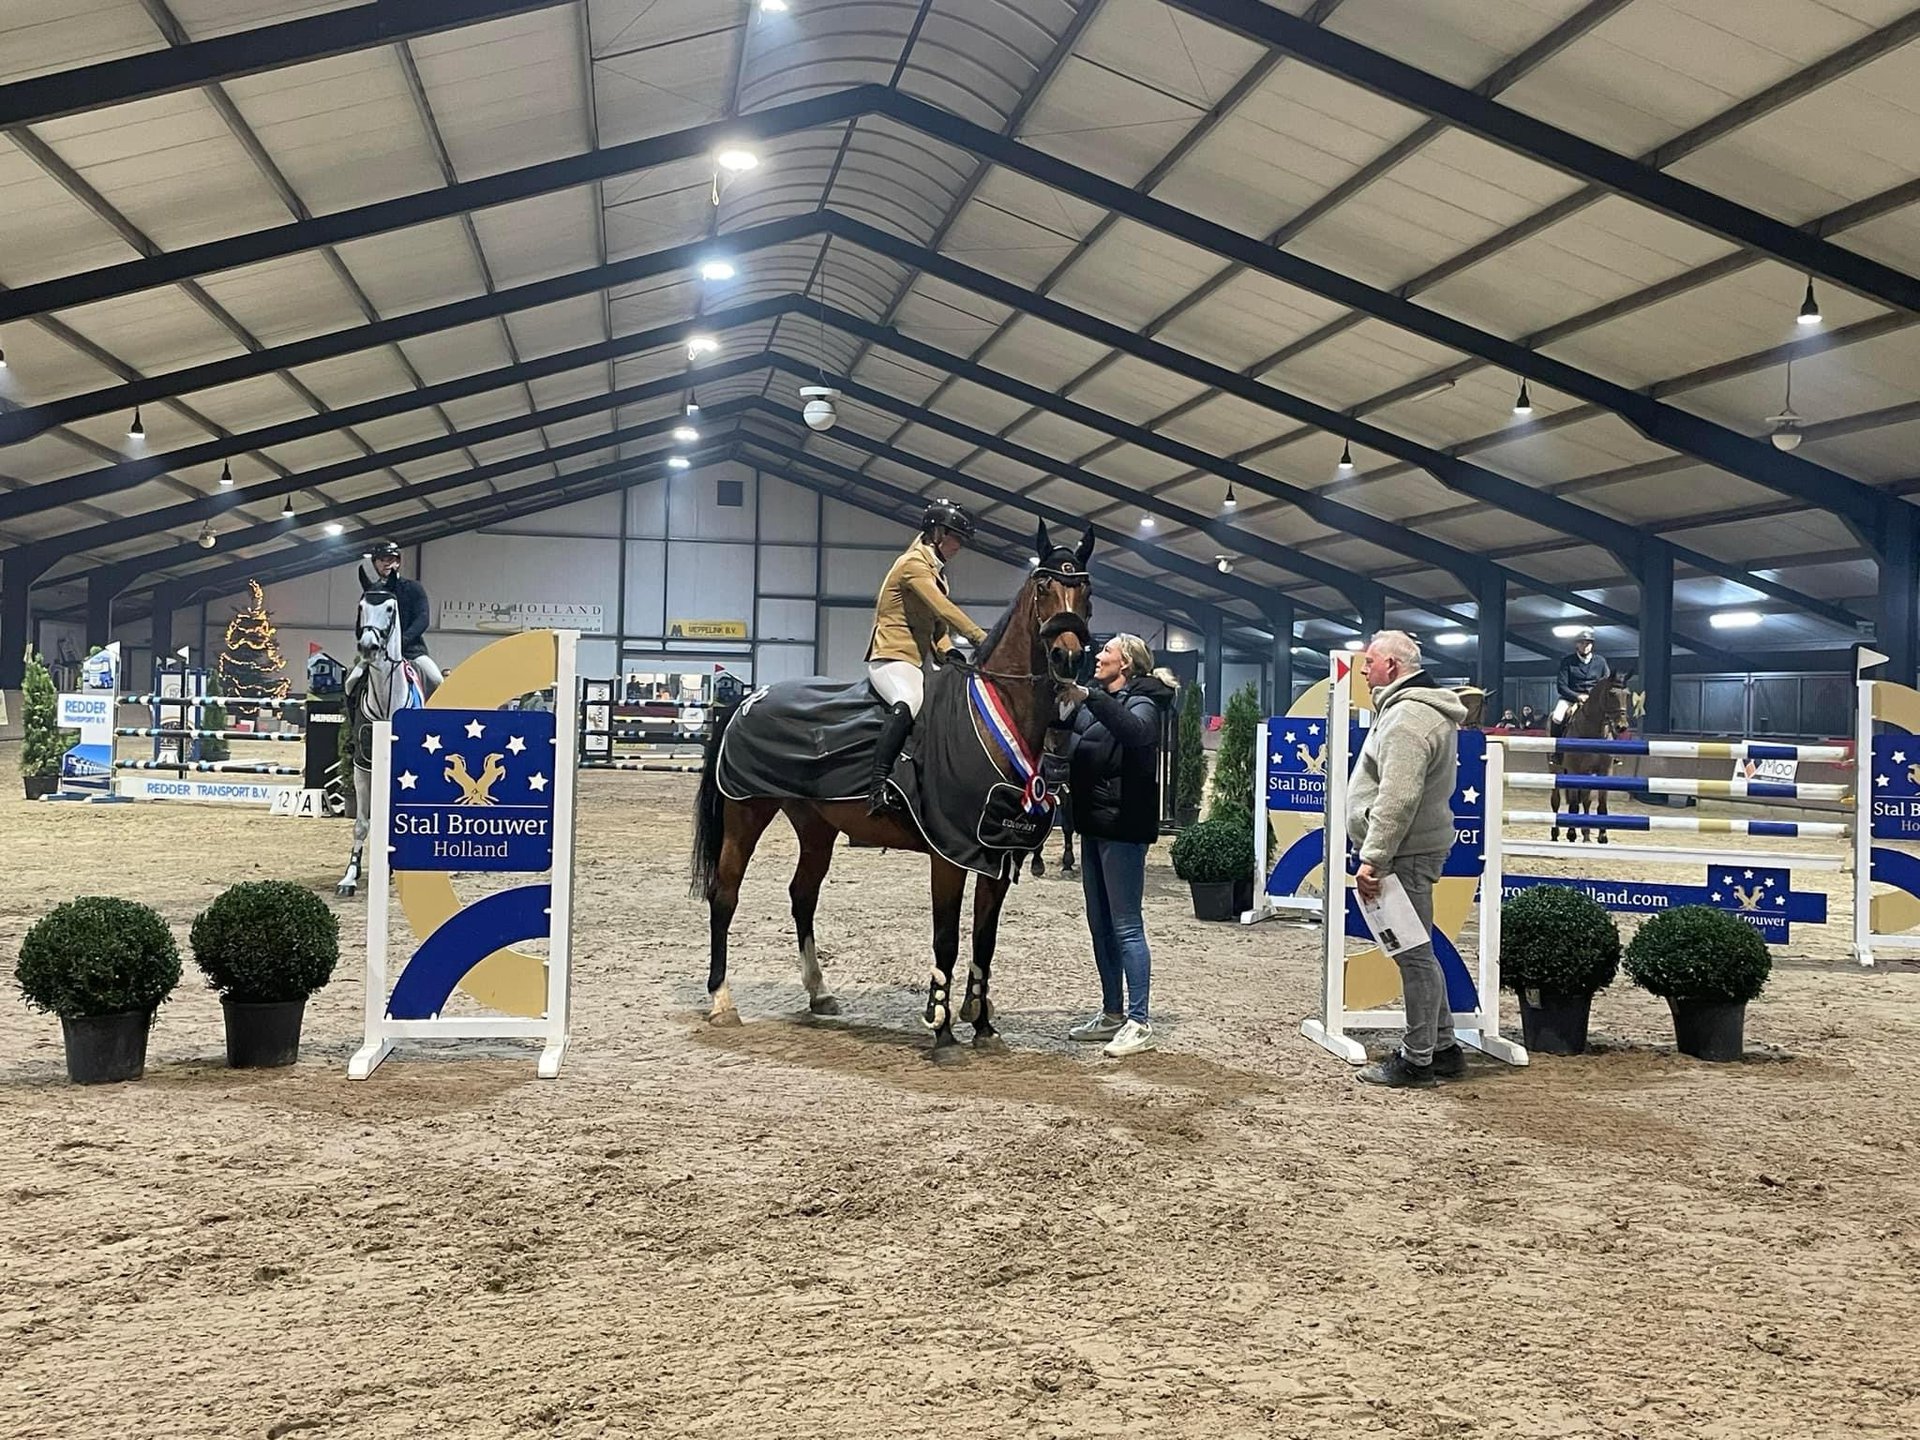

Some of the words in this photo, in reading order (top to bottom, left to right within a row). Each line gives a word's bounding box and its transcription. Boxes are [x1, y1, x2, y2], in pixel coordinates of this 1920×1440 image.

[443, 600, 501, 613] HIPPO
[513, 604, 601, 616] HOLLAND
[65, 700, 107, 714] REDDER
[147, 782, 191, 796] REDDER
[197, 784, 250, 798] TRANSPORT
[252, 787, 271, 799] B.V.
[1269, 776, 1295, 791] Stal
[301, 794, 312, 812] A
[1874, 801, 1905, 816] Stal
[394, 812, 439, 835] Stal
[447, 814, 548, 836] Brouwer
[433, 841, 508, 858] Holland
